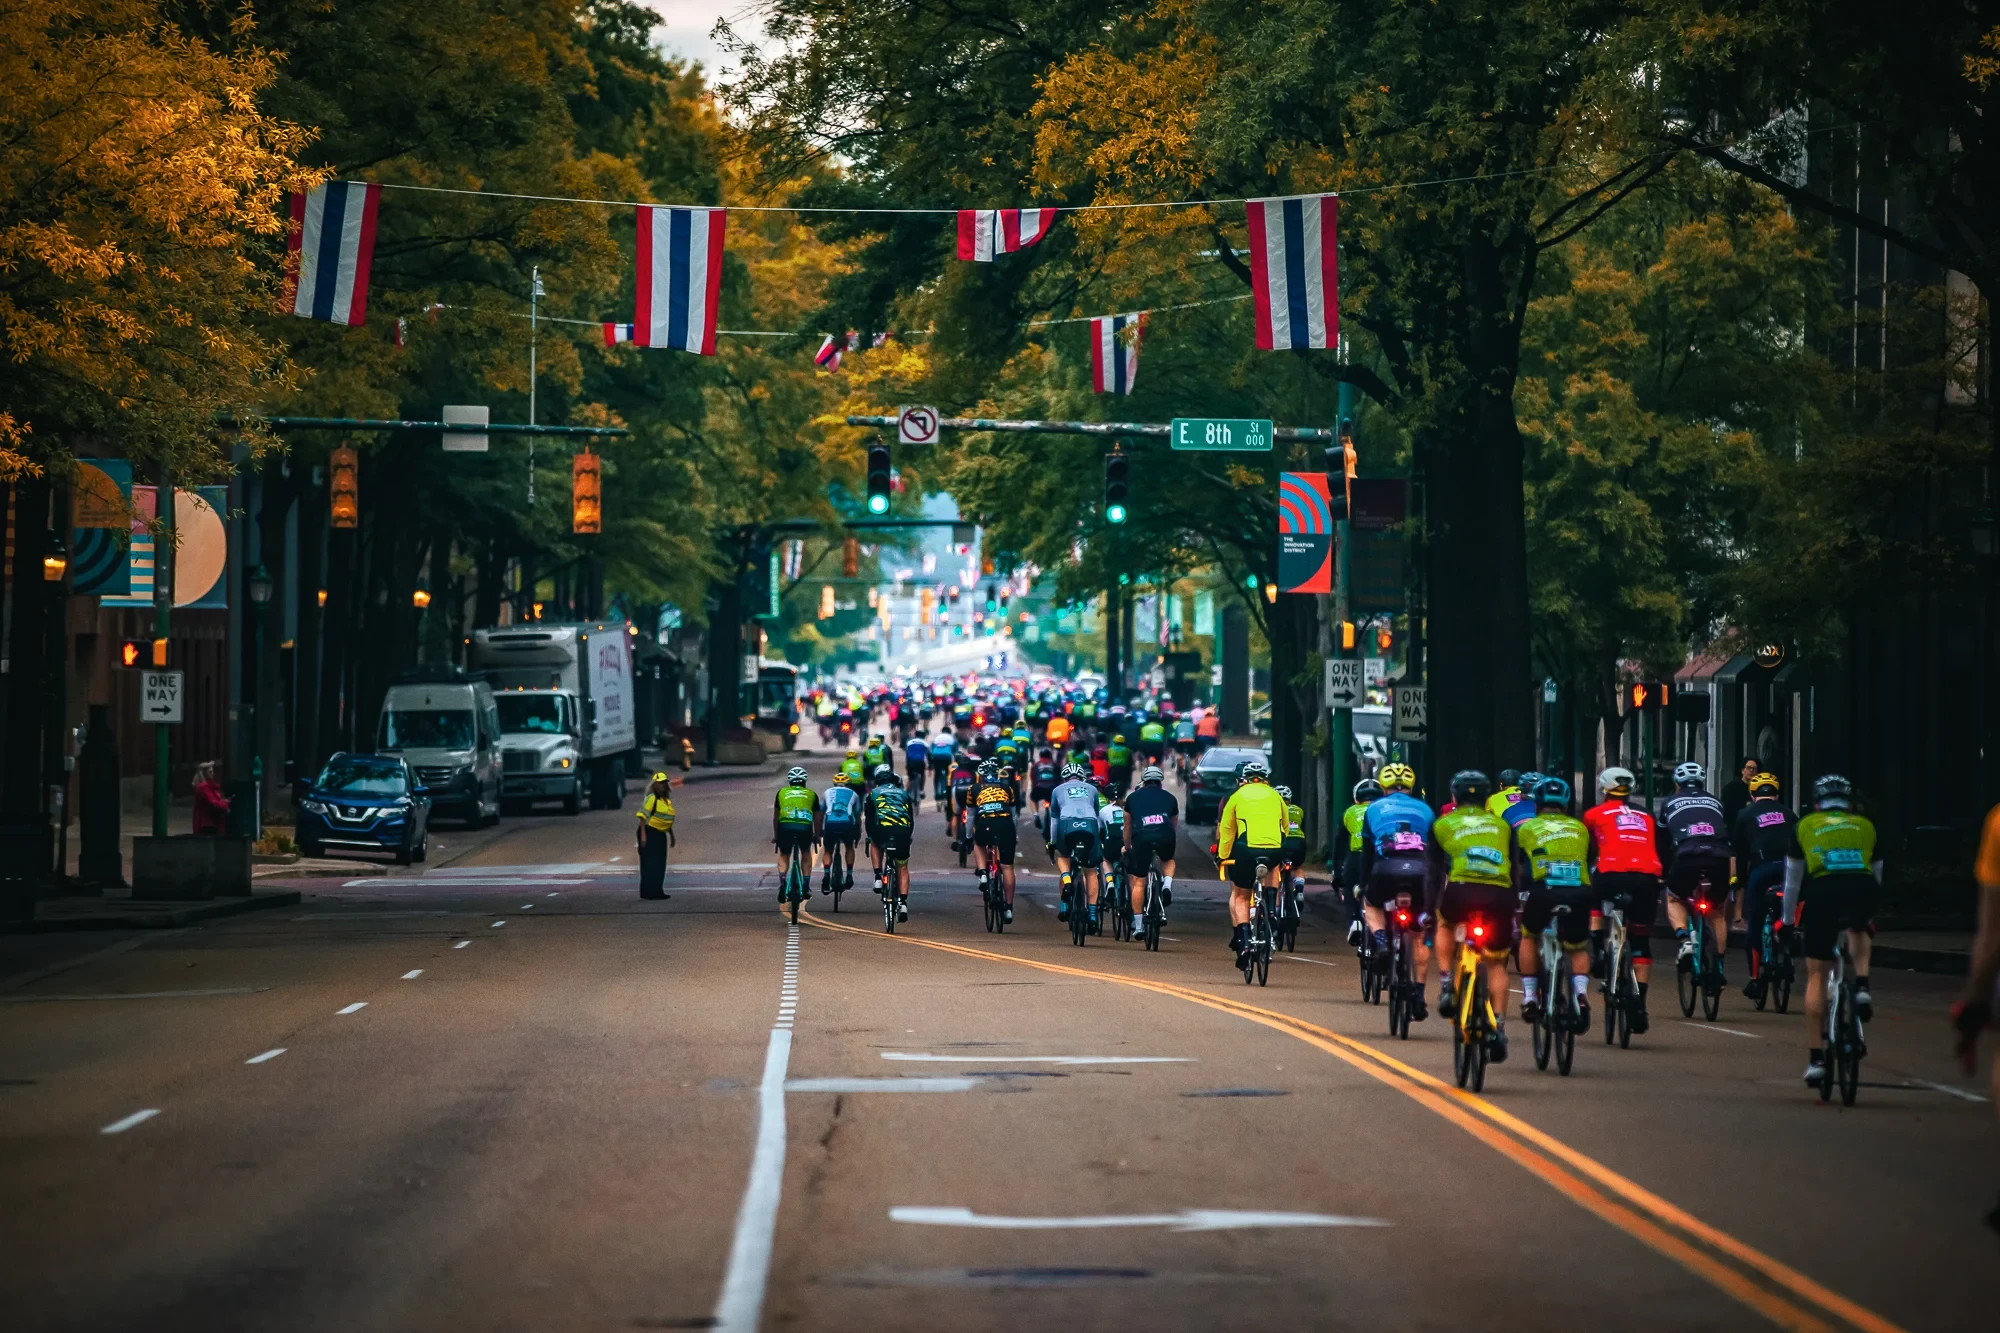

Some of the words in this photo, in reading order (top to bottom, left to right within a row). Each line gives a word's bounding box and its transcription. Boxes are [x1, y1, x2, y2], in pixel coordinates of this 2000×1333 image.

[1180, 422, 1194, 444] E.
[1205, 422, 1232, 445] 8th
[1250, 422, 1259, 433] St
[1245, 434, 1265, 446] 000
[1332, 663, 1359, 675] ONE
[148, 675, 177, 688] ONE
[1332, 676, 1359, 688] WAY
[147, 688, 178, 701] WAY
